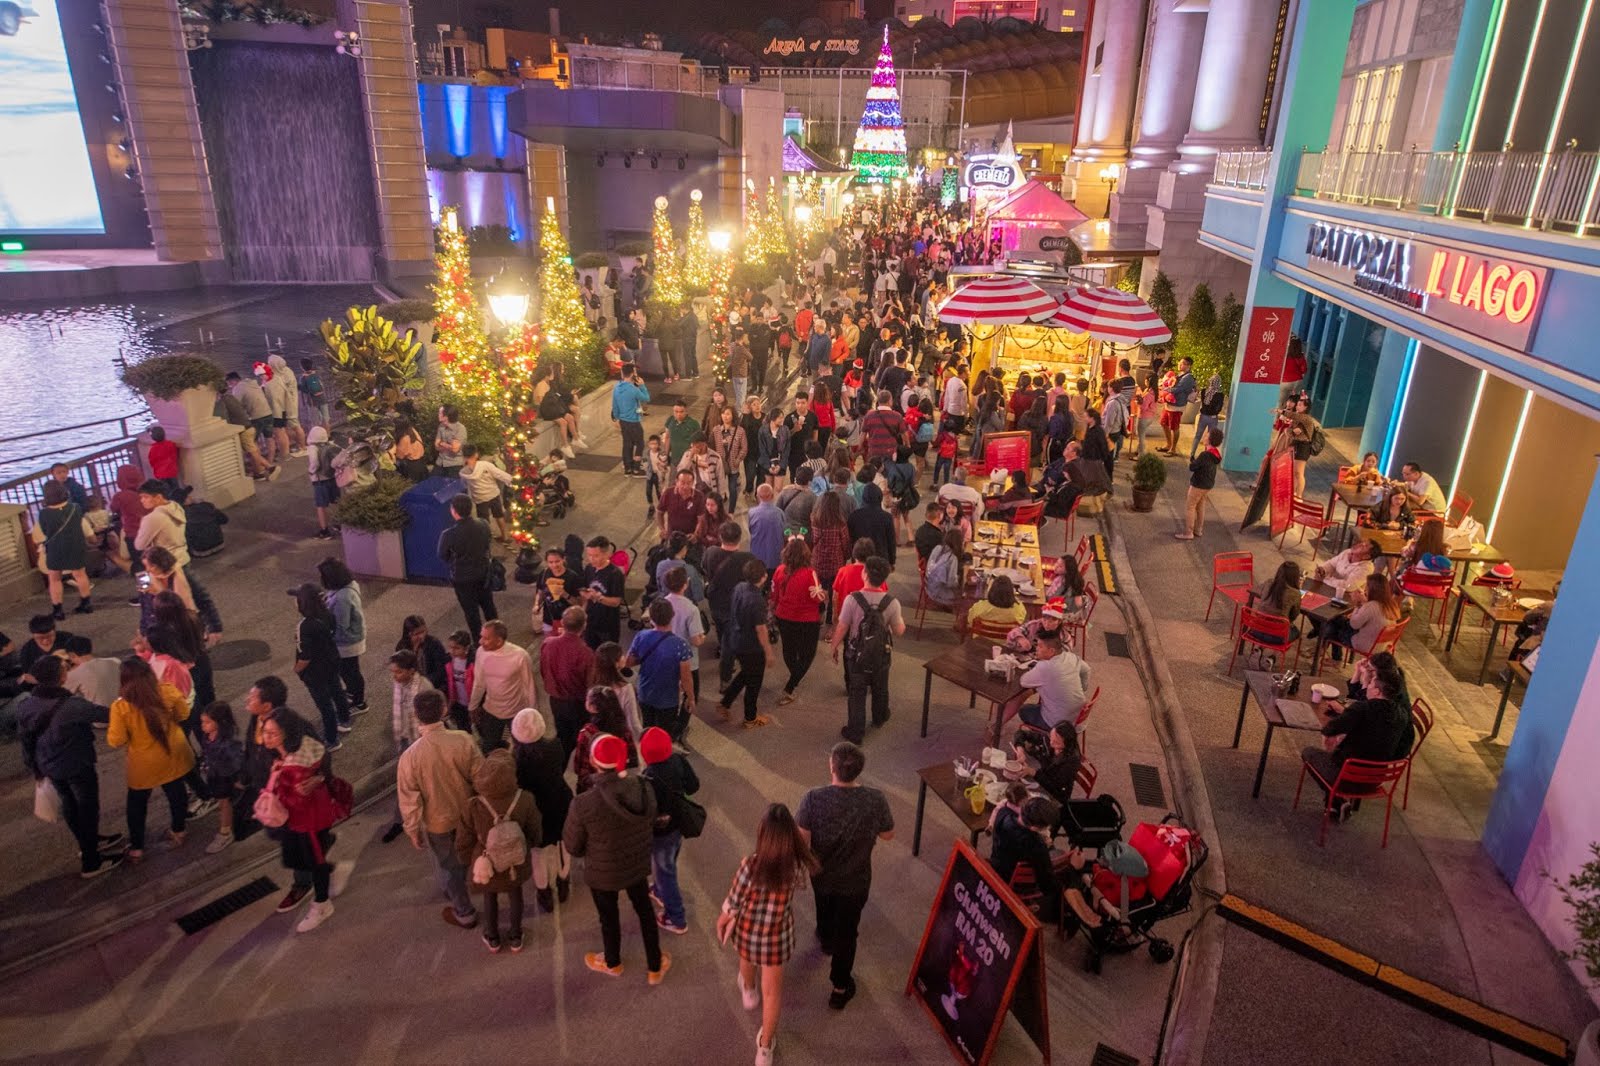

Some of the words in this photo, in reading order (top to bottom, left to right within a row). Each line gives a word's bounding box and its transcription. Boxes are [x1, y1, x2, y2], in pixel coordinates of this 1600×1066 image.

[763, 36, 806, 56] ARENA
[824, 39, 860, 56] STARS
[1449, 255, 1536, 323] LAGO
[975, 879, 1001, 917] Hot
[955, 910, 977, 946] RM
[975, 937, 995, 967] 20
